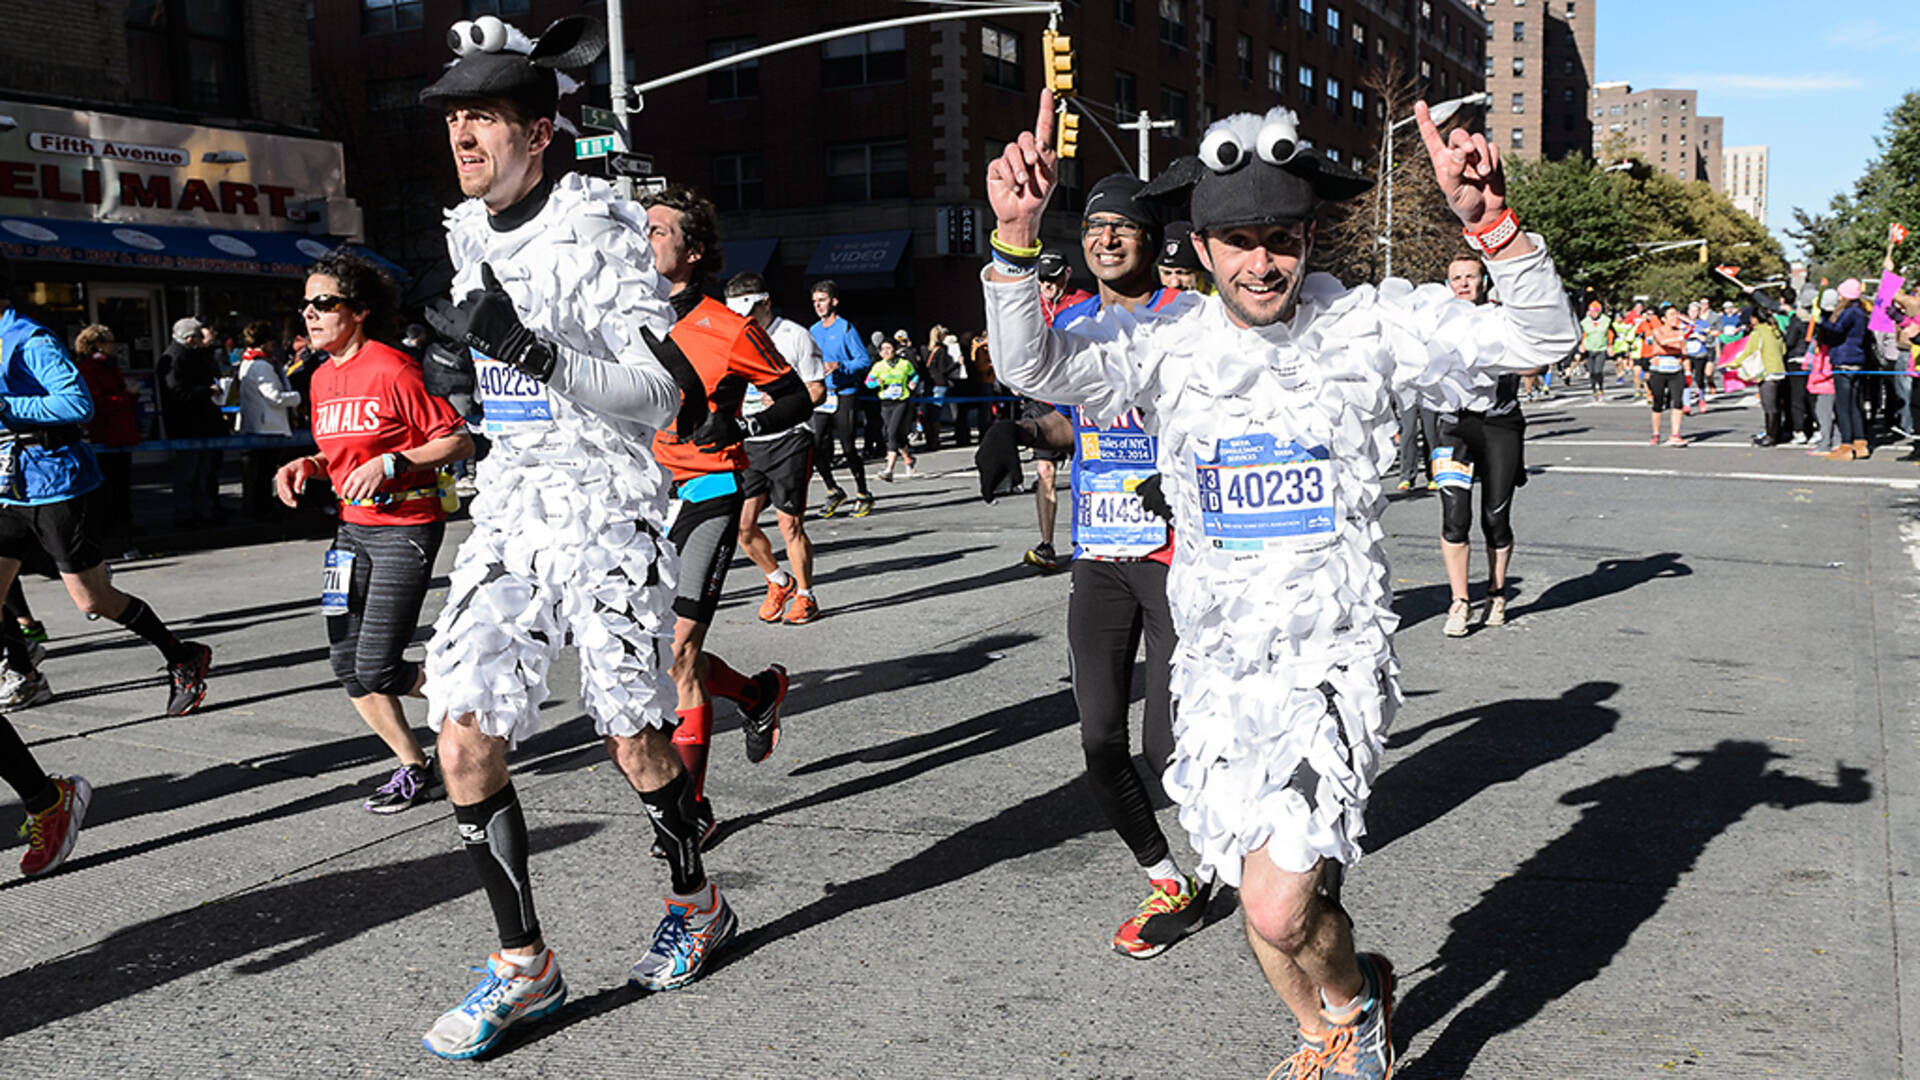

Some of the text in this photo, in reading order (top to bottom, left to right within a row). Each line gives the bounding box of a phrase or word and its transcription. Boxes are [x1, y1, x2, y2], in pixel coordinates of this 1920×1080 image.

[39, 135, 184, 165] Fifth Avenue
[119, 172, 295, 217] MART
[831, 250, 887, 263] VIDEO
[340, 401, 379, 431] ALS
[1127, 450, 1149, 459] 2014
[1129, 438, 1148, 450] NYC
[1206, 470, 1216, 489] 3
[1228, 467, 1324, 508] 40233
